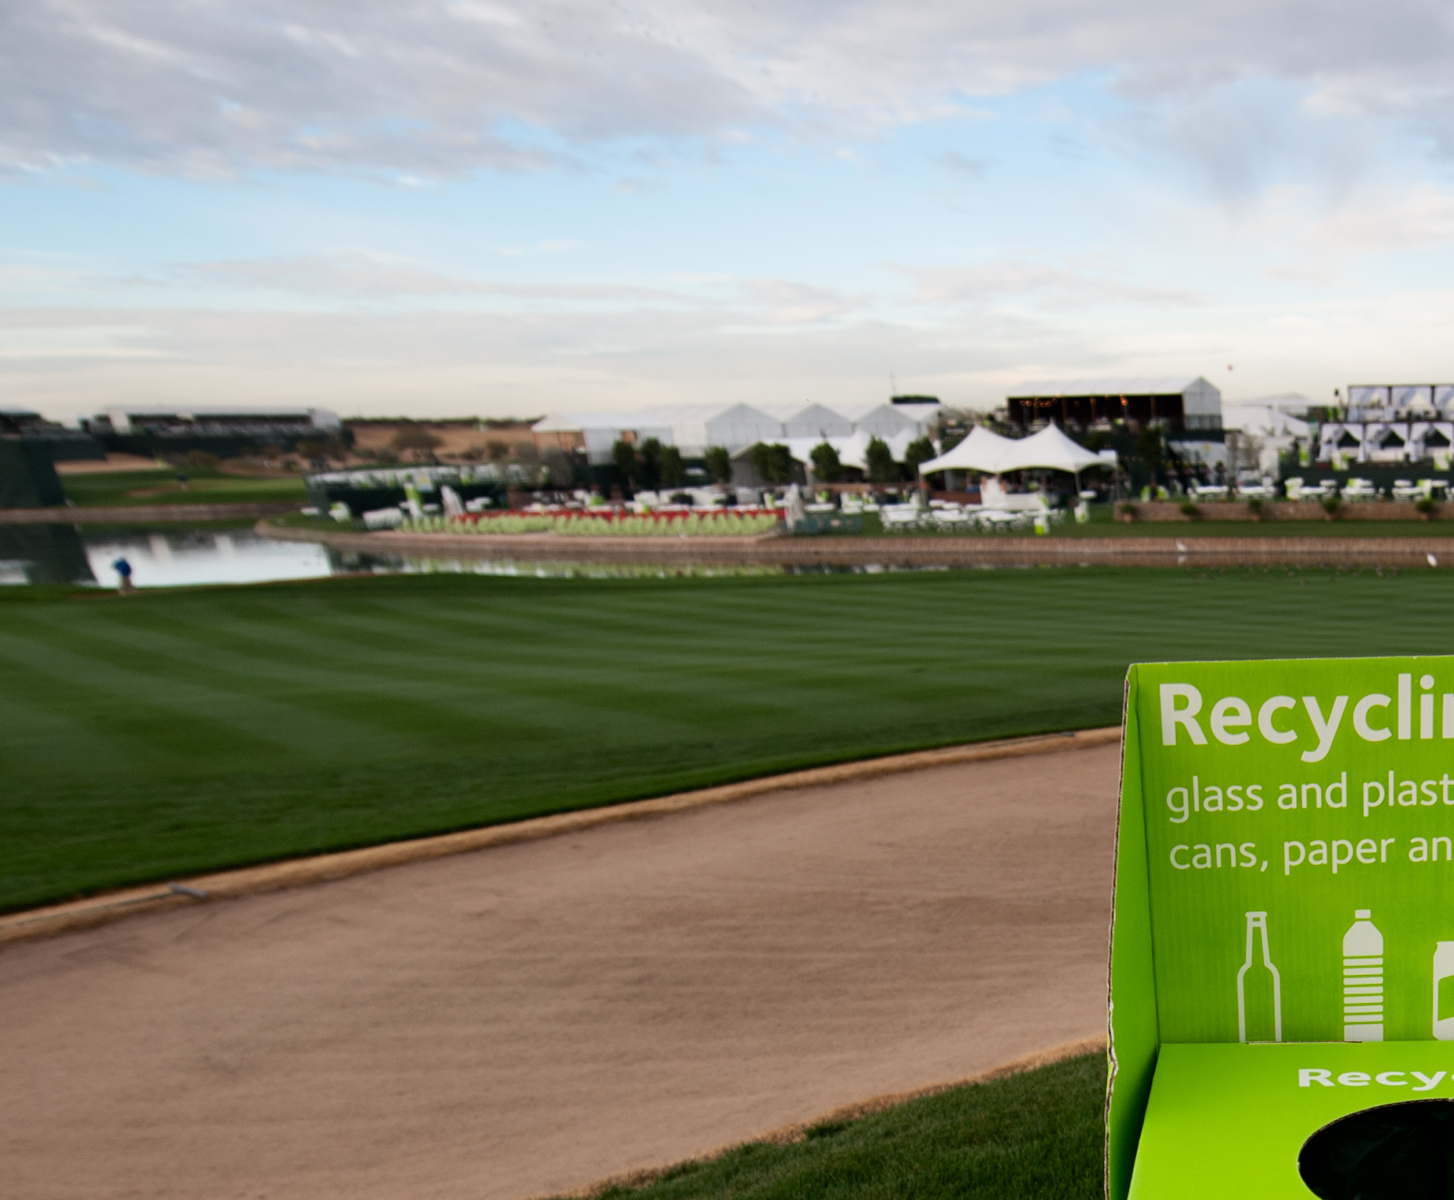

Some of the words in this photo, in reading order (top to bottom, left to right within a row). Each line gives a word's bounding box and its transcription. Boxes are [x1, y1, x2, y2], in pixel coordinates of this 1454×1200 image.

[1167, 775, 1263, 823] glass
[1278, 771, 1347, 809] and
[1170, 842, 1268, 871] cans,
[1284, 838, 1395, 875] paper
